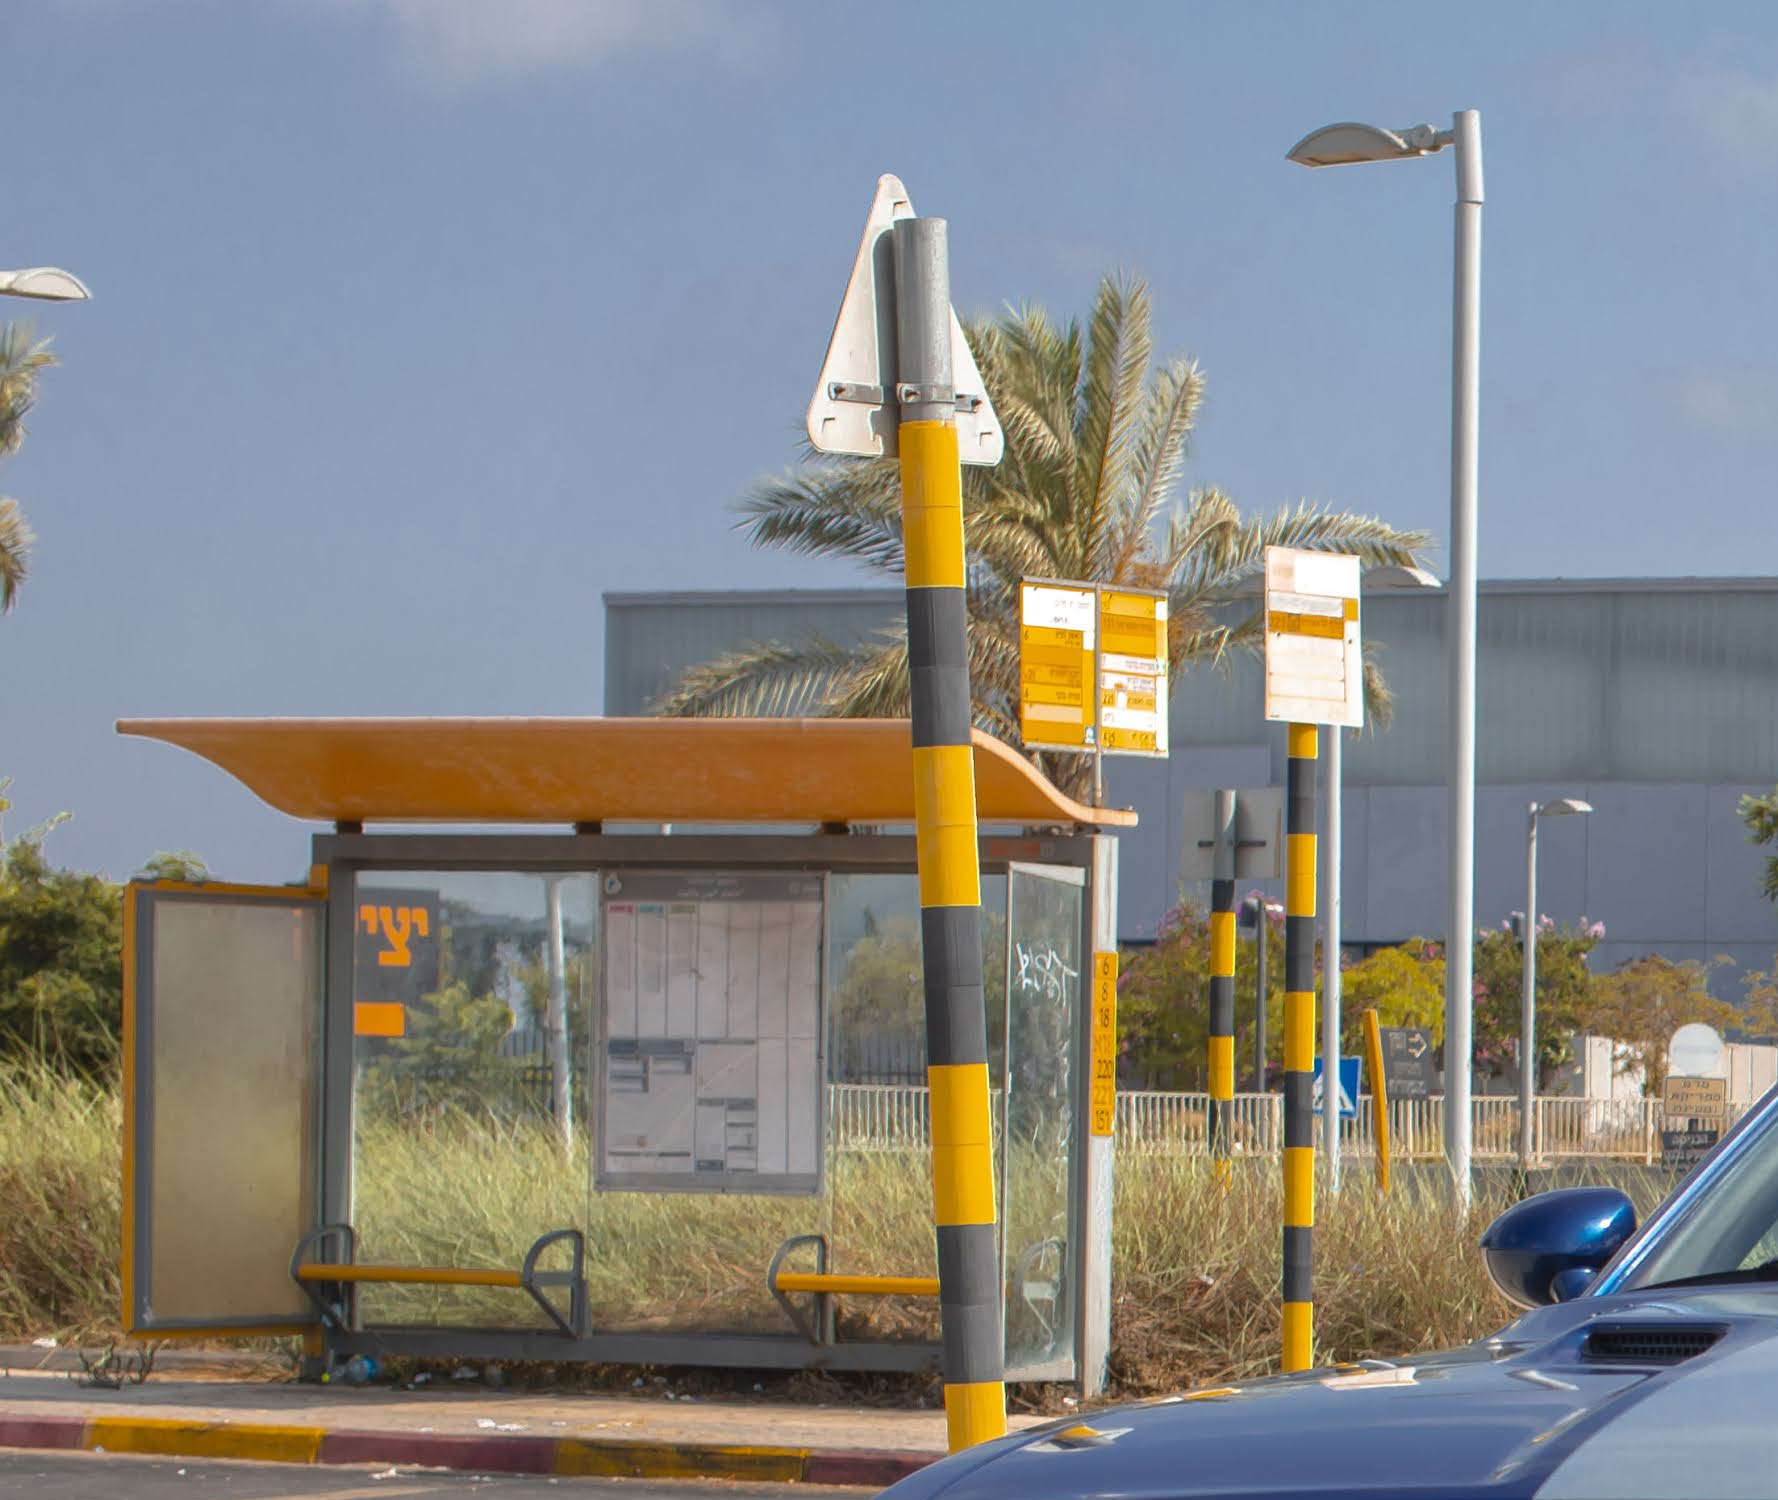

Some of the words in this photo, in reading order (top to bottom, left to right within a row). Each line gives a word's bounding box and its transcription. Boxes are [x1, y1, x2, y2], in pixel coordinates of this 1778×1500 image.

[1102, 958, 1110, 975] 6
[1101, 983, 1109, 1001] 8
[1099, 1008, 1110, 1028] 18
